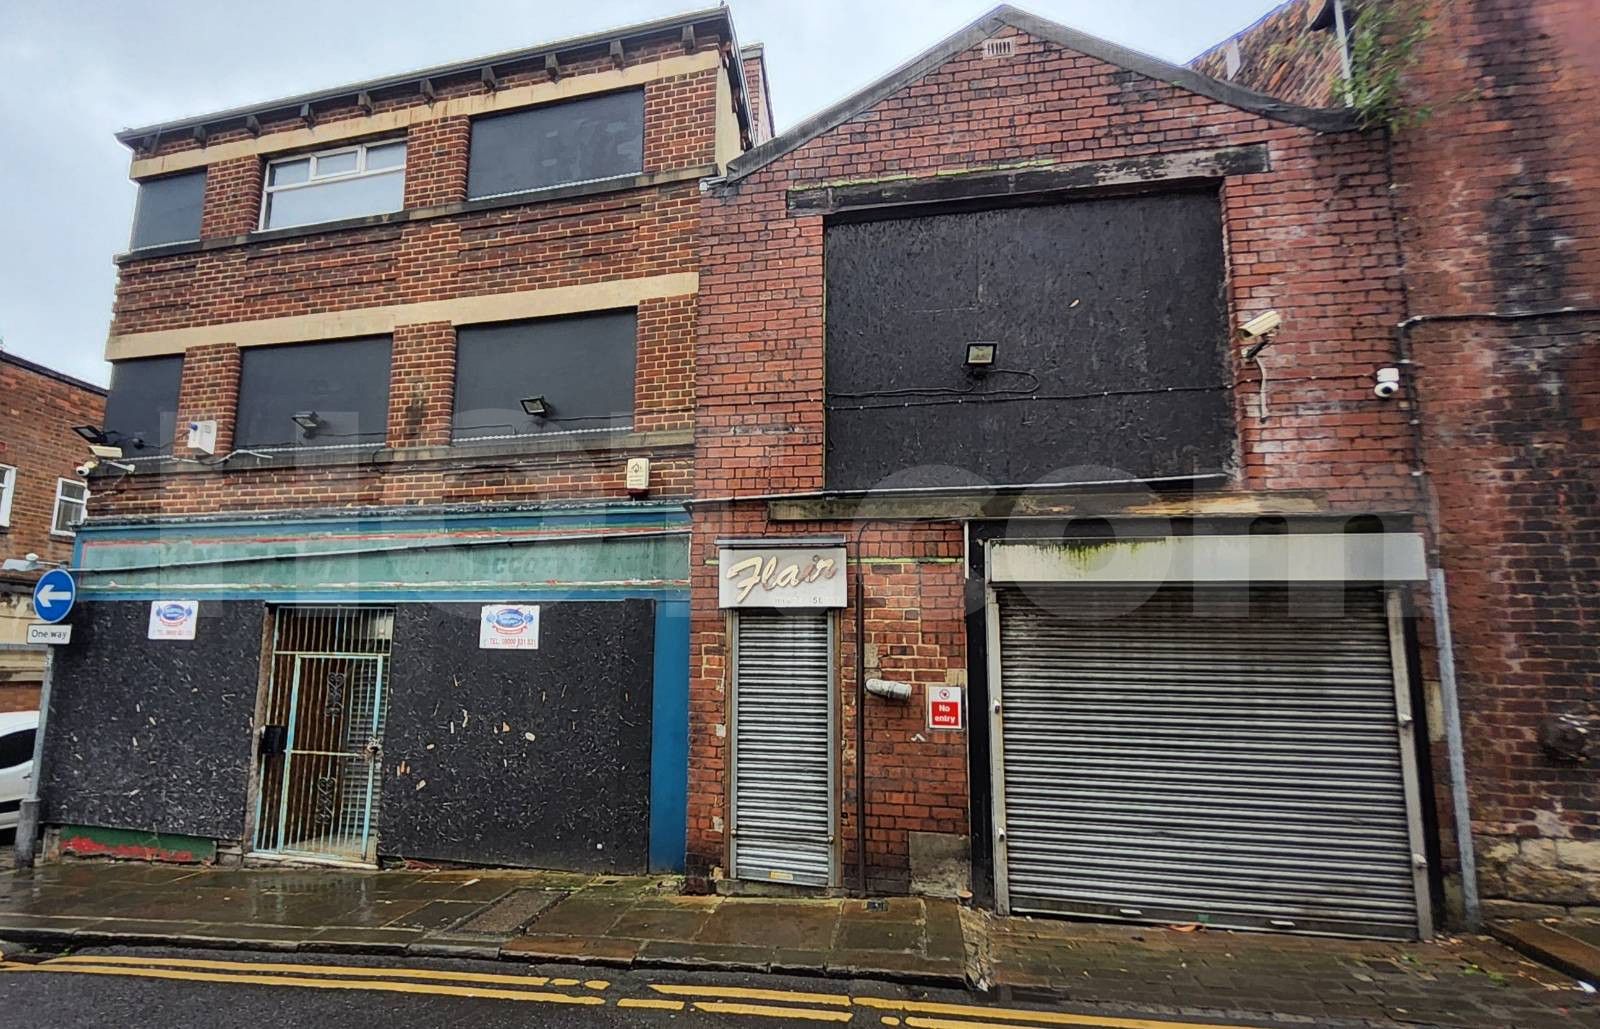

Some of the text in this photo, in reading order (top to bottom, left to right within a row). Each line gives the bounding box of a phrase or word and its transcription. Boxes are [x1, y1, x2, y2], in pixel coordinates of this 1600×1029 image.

[726, 554, 838, 604] Flair
[31, 629, 68, 641] One way
[938, 704, 951, 712] No
[934, 715, 956, 724] entry
